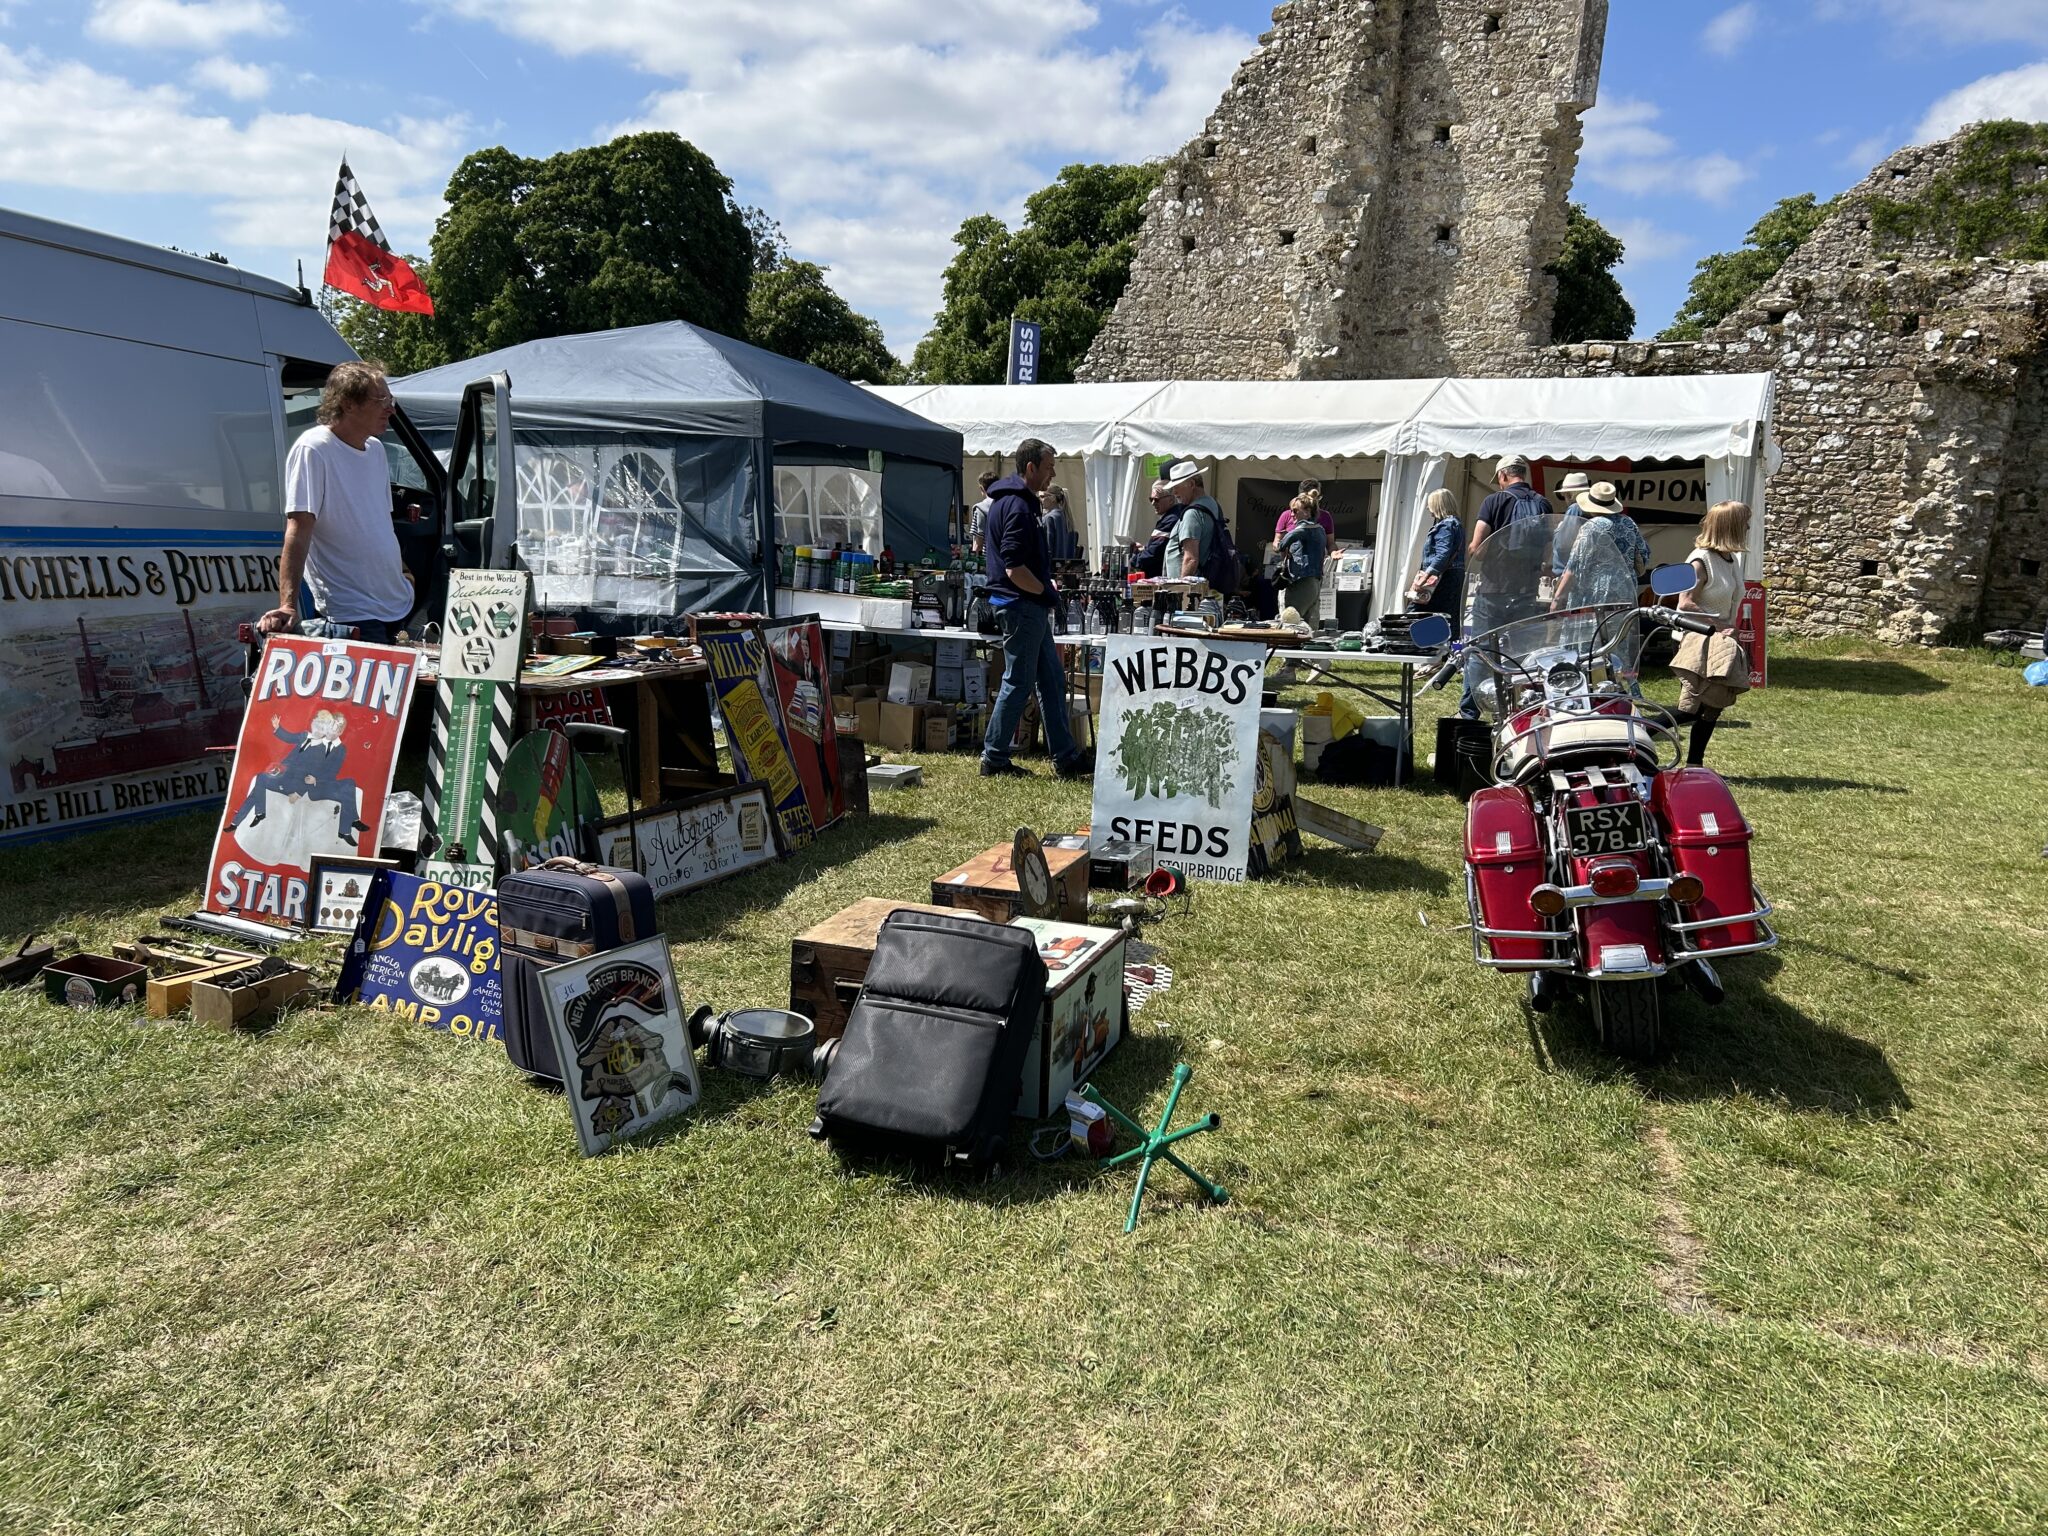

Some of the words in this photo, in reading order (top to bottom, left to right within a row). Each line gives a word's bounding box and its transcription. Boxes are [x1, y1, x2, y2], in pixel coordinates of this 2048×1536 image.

[1018, 327, 1034, 384] RESS
[1555, 479, 1706, 502] MPION
[143, 560, 166, 596] &
[163, 550, 281, 605] BUTLERS
[460, 572, 474, 580] Best
[496, 573, 516, 583] World
[257, 647, 410, 717] ROBIN
[1112, 646, 1262, 705] WEBBS'
[53, 790, 109, 818] HILL
[1579, 806, 1631, 831] RSX
[648, 805, 728, 871] Autograph
[1573, 830, 1645, 854] 378J
[655, 875, 668, 888] 10
[703, 858, 717, 874] 20
[718, 857, 729, 869] for
[215, 861, 308, 921] STAR
[363, 971, 376, 983] OIL
[364, 960, 405, 979] AMERICAN
[570, 999, 588, 1028] NEW
[586, 969, 618, 1001] FOREST
[620, 969, 662, 996] BRANCH
